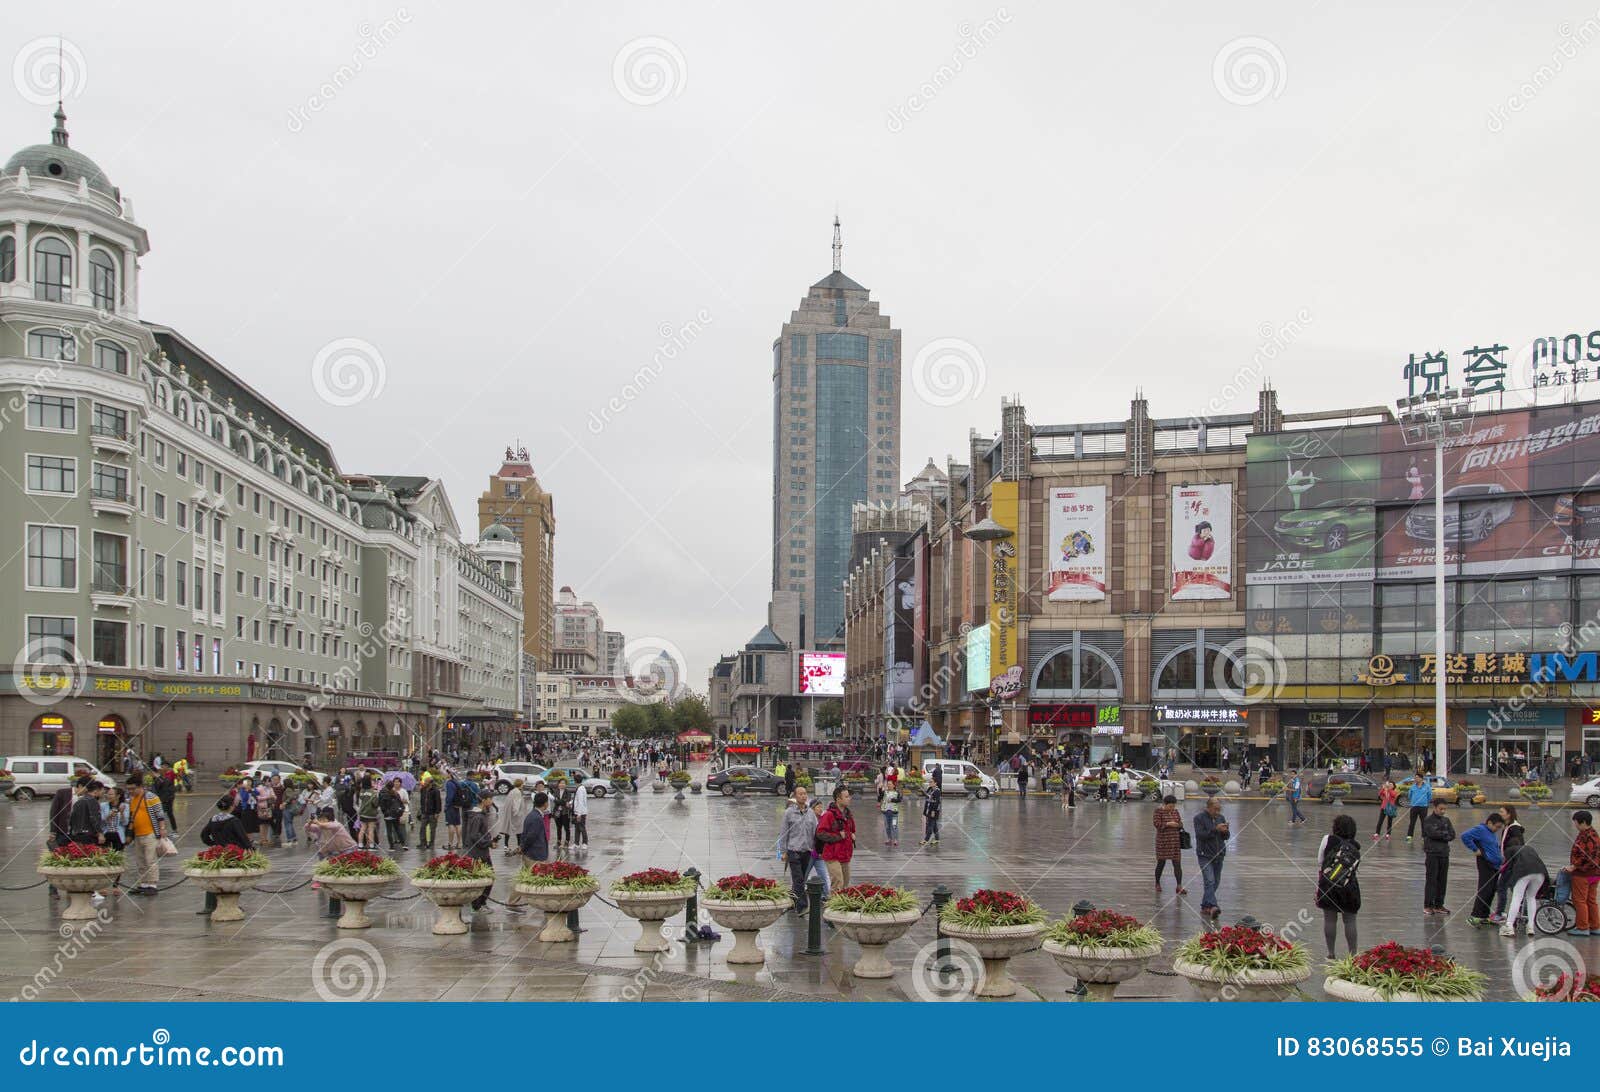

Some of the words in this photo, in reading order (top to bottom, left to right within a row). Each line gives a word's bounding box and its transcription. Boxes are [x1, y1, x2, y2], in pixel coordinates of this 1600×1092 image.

[1534, 366, 1600, 388] 哈尔滨
[1542, 545, 1600, 558] CIVI
[1395, 555, 1467, 565] SPIROR
[1256, 560, 1317, 572] JADE
[1420, 652, 1525, 674] 万达影城
[1421, 676, 1464, 684] WADA
[1472, 675, 1520, 684] CINEMA
[162, 685, 241, 696] 4000-114-808
[1165, 709, 1238, 719] 酸奶冰淇淋牛排杯
